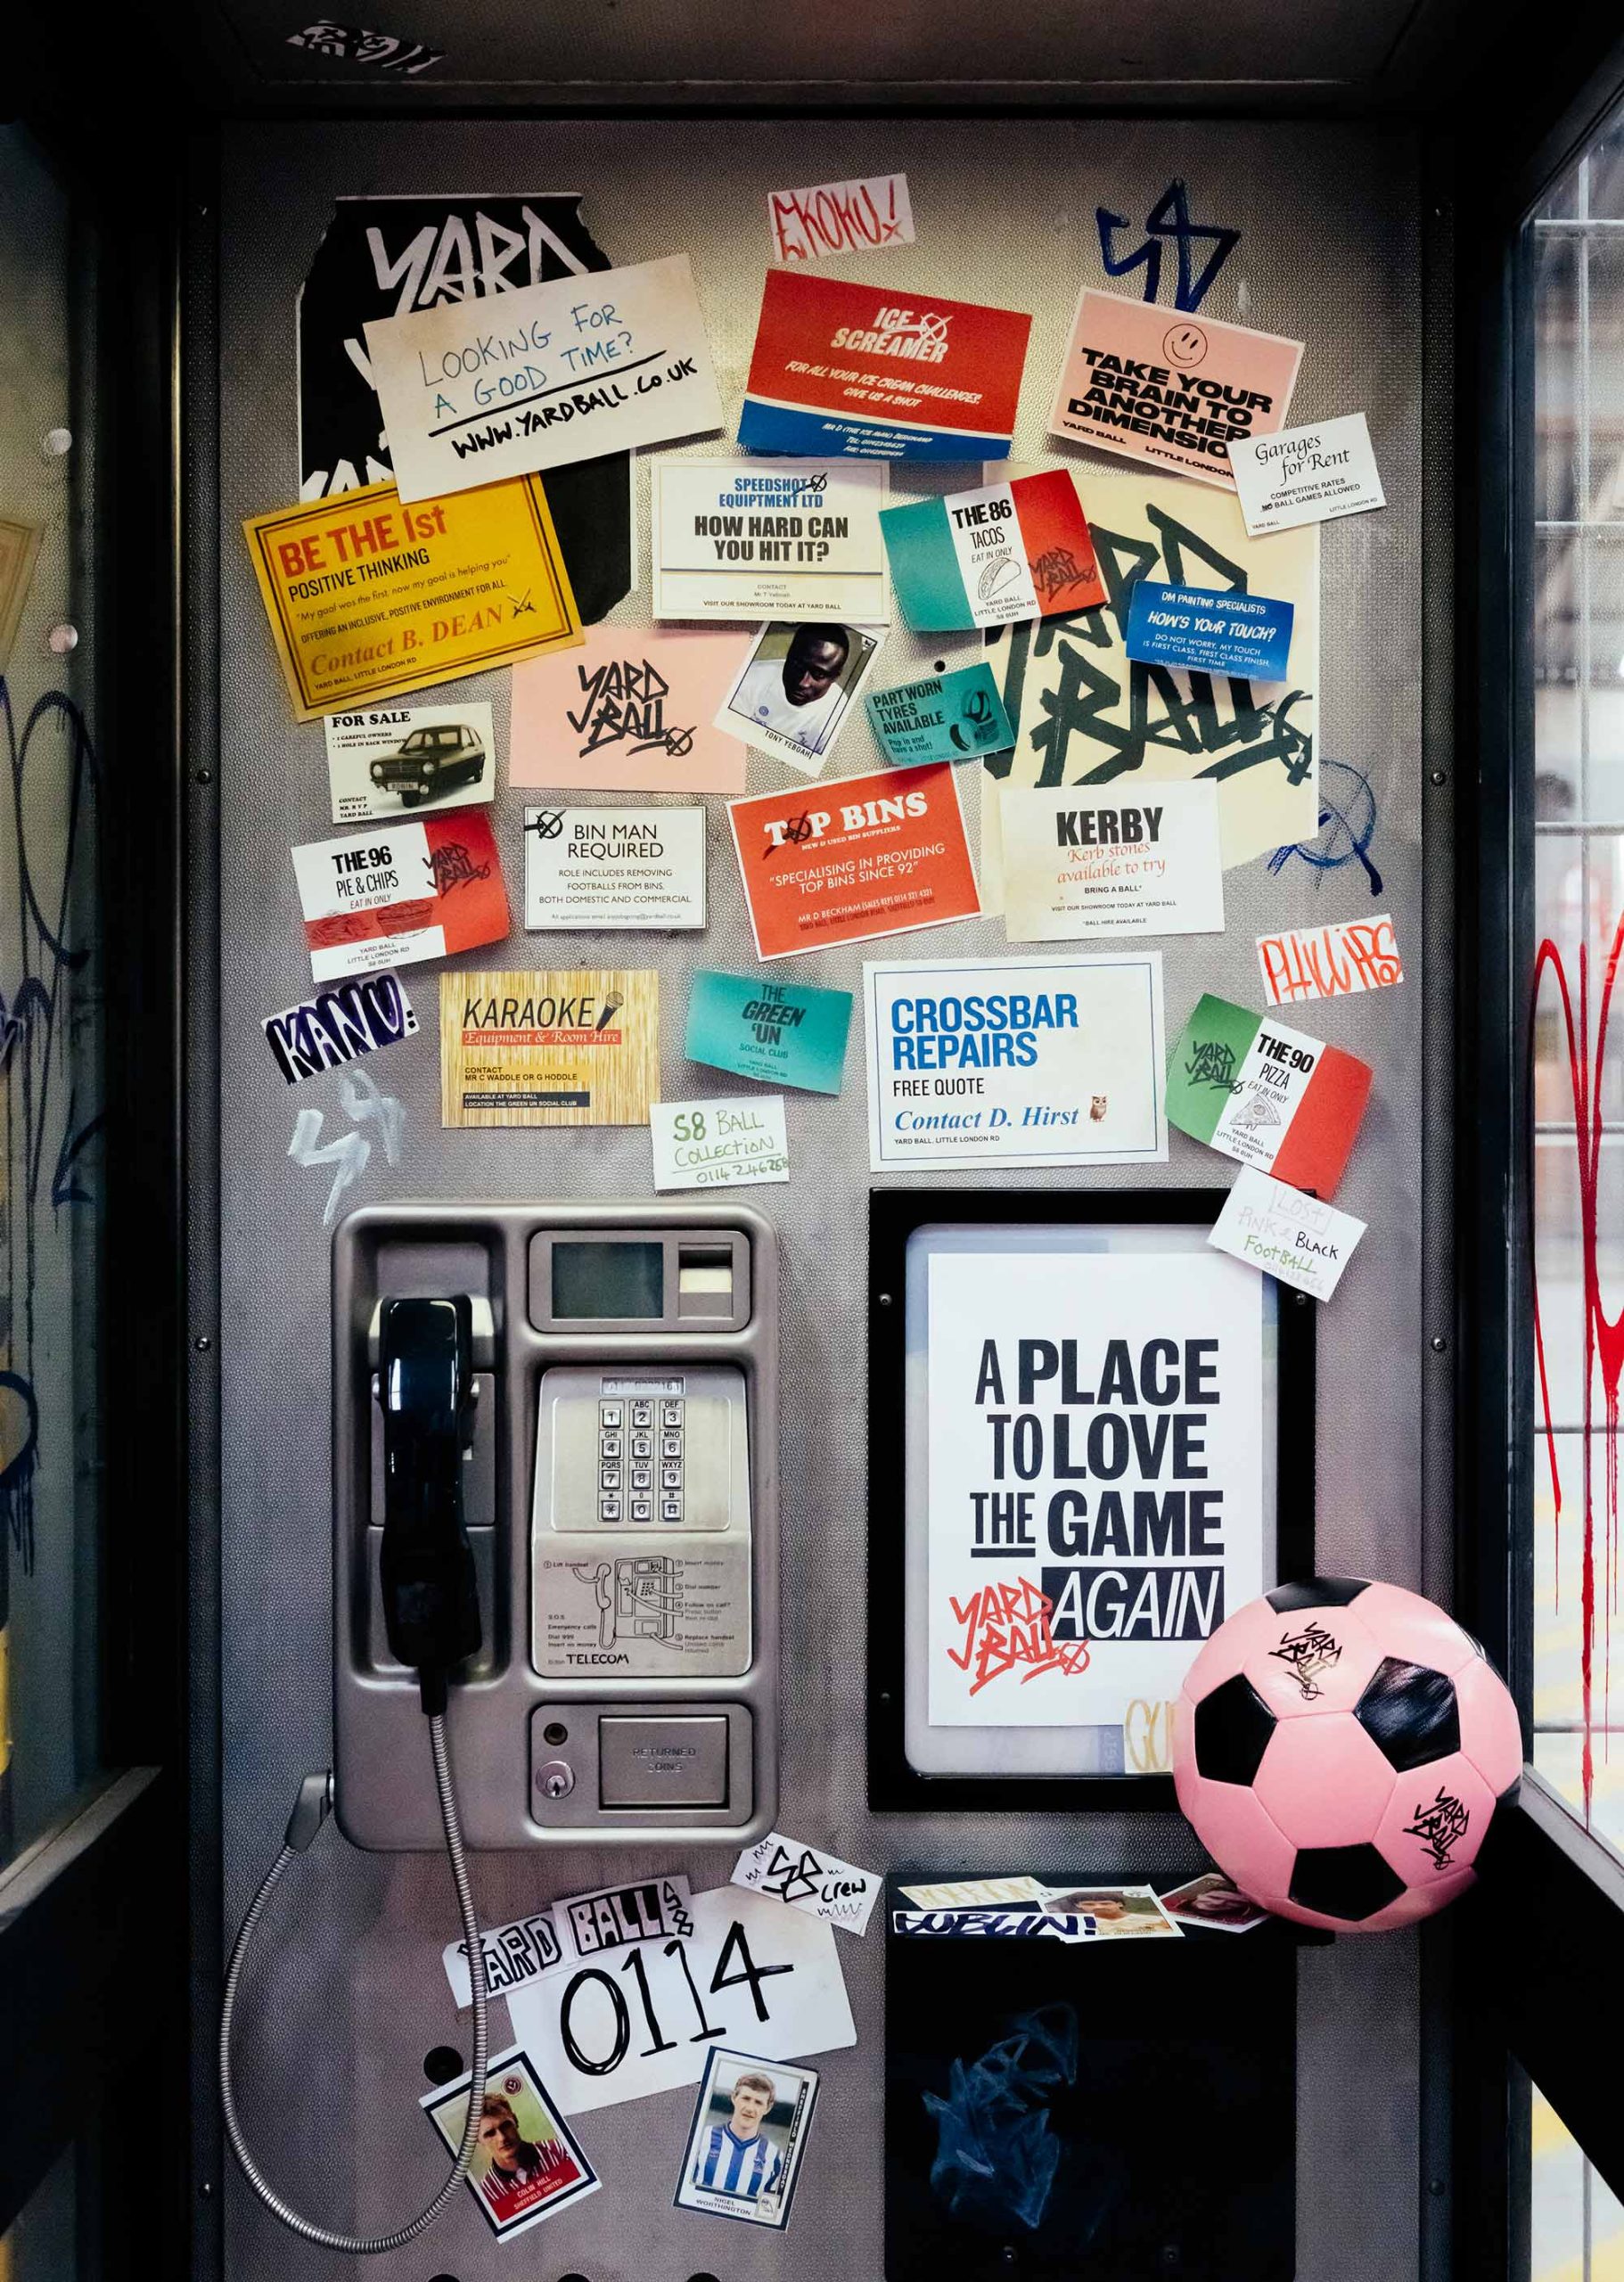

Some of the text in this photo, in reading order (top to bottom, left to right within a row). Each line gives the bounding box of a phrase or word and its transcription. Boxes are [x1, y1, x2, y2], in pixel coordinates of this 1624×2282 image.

[873, 308, 914, 329] ICE
[419, 304, 623, 387] LOOKING FOR
[831, 328, 948, 363] SCREAMER
[434, 394, 457, 418] A
[474, 365, 547, 405] GOOD
[1082, 348, 1273, 414] TAKE YOUR
[1090, 369, 1253, 426] BRAIN TO
[1084, 387, 1251, 440] ANOTHER
[1067, 398, 1230, 459] DIMENSIO
[1255, 434, 1322, 465] Garages
[1280, 448, 1350, 486] for Rent
[734, 479, 808, 492] SPEEDSHOT
[1270, 477, 1346, 500] COMPETITIVE RATES
[1275, 499, 1294, 509] BALL
[1295, 492, 1322, 505] GAMES
[1323, 483, 1360, 499] ALLOWED
[719, 494, 823, 508] EQUIPTMENT LTD
[952, 499, 1013, 529] THE 86
[694, 515, 849, 538] HOW HARD CAN
[970, 527, 1005, 549] TACOS
[278, 536, 327, 579] BE
[326, 513, 399, 562] THE
[714, 540, 830, 562] YOU HIT IT?
[288, 548, 430, 603] POSITIVE THINKING
[1161, 591, 1267, 614] DM PAINTING SPECIALISTS
[1147, 611, 1191, 628] HOW'S
[1229, 622, 1276, 642] TOUCH?
[311, 605, 504, 677] Contact B. DEAN
[1169, 636, 1185, 644] NOT
[1234, 645, 1260, 656] TOUCH
[872, 681, 942, 707] PART WORN
[332, 711, 411, 727] FOR SALE
[878, 702, 917, 720] TYRES
[882, 712, 945, 735] AVAILABLE
[765, 730, 814, 759] TONY YEBOAH
[840, 792, 928, 831] BINS
[575, 825, 657, 840] BIN MAN
[1056, 807, 1163, 846] KERBY
[332, 845, 392, 874] THE 96
[568, 843, 664, 860] REQUIRED
[859, 858, 873, 868] IN
[877, 843, 946, 866] PROVIDING
[1068, 841, 1151, 863] Kerb stones
[336, 870, 399, 898] PIE & CHIPS
[627, 869, 673, 877] REMOVING
[799, 881, 824, 894] TOP
[827, 874, 856, 886] BINS
[859, 866, 895, 882] SINCE
[1057, 858, 1166, 884] available to try
[566, 896, 610, 904] DOMESTIC
[1084, 886, 1110, 894] BRING
[761, 983, 787, 1003] THE
[463, 997, 595, 1029] KARAOKE
[742, 1001, 806, 1027] GREEN
[891, 994, 1079, 1034] CROSSBAR
[465, 1031, 619, 1044] Equipment & Room Hire
[892, 1031, 1038, 1071] REPAIRS
[1258, 1033, 1315, 1073] THE 90
[893, 1078, 985, 1096] FREE QUOTE
[1259, 1063, 1291, 1090] PIZZA
[674, 1110, 764, 1141] S8 BALL
[895, 1106, 1079, 1131] Contact D. Hirst
[1295, 1231, 1339, 1260] BLACK
[974, 1338, 1221, 1406] A PLACE
[635, 1400, 679, 1408] ABC DEF
[987, 1413, 1209, 1480] TO LOVE
[971, 1490, 1225, 1557] THE GAME
[1050, 1570, 1220, 1639] AGAIN
[566, 1654, 628, 1664] TELECOM
[632, 1747, 696, 1758] RETURNED
[648, 1762, 684, 1772] COINS
[567, 1884, 665, 1956] BALL
[561, 1921, 794, 2076] 0114
[696, 2199, 751, 2216] WORTHINGTON
[714, 2197, 734, 2206] NIGEL
